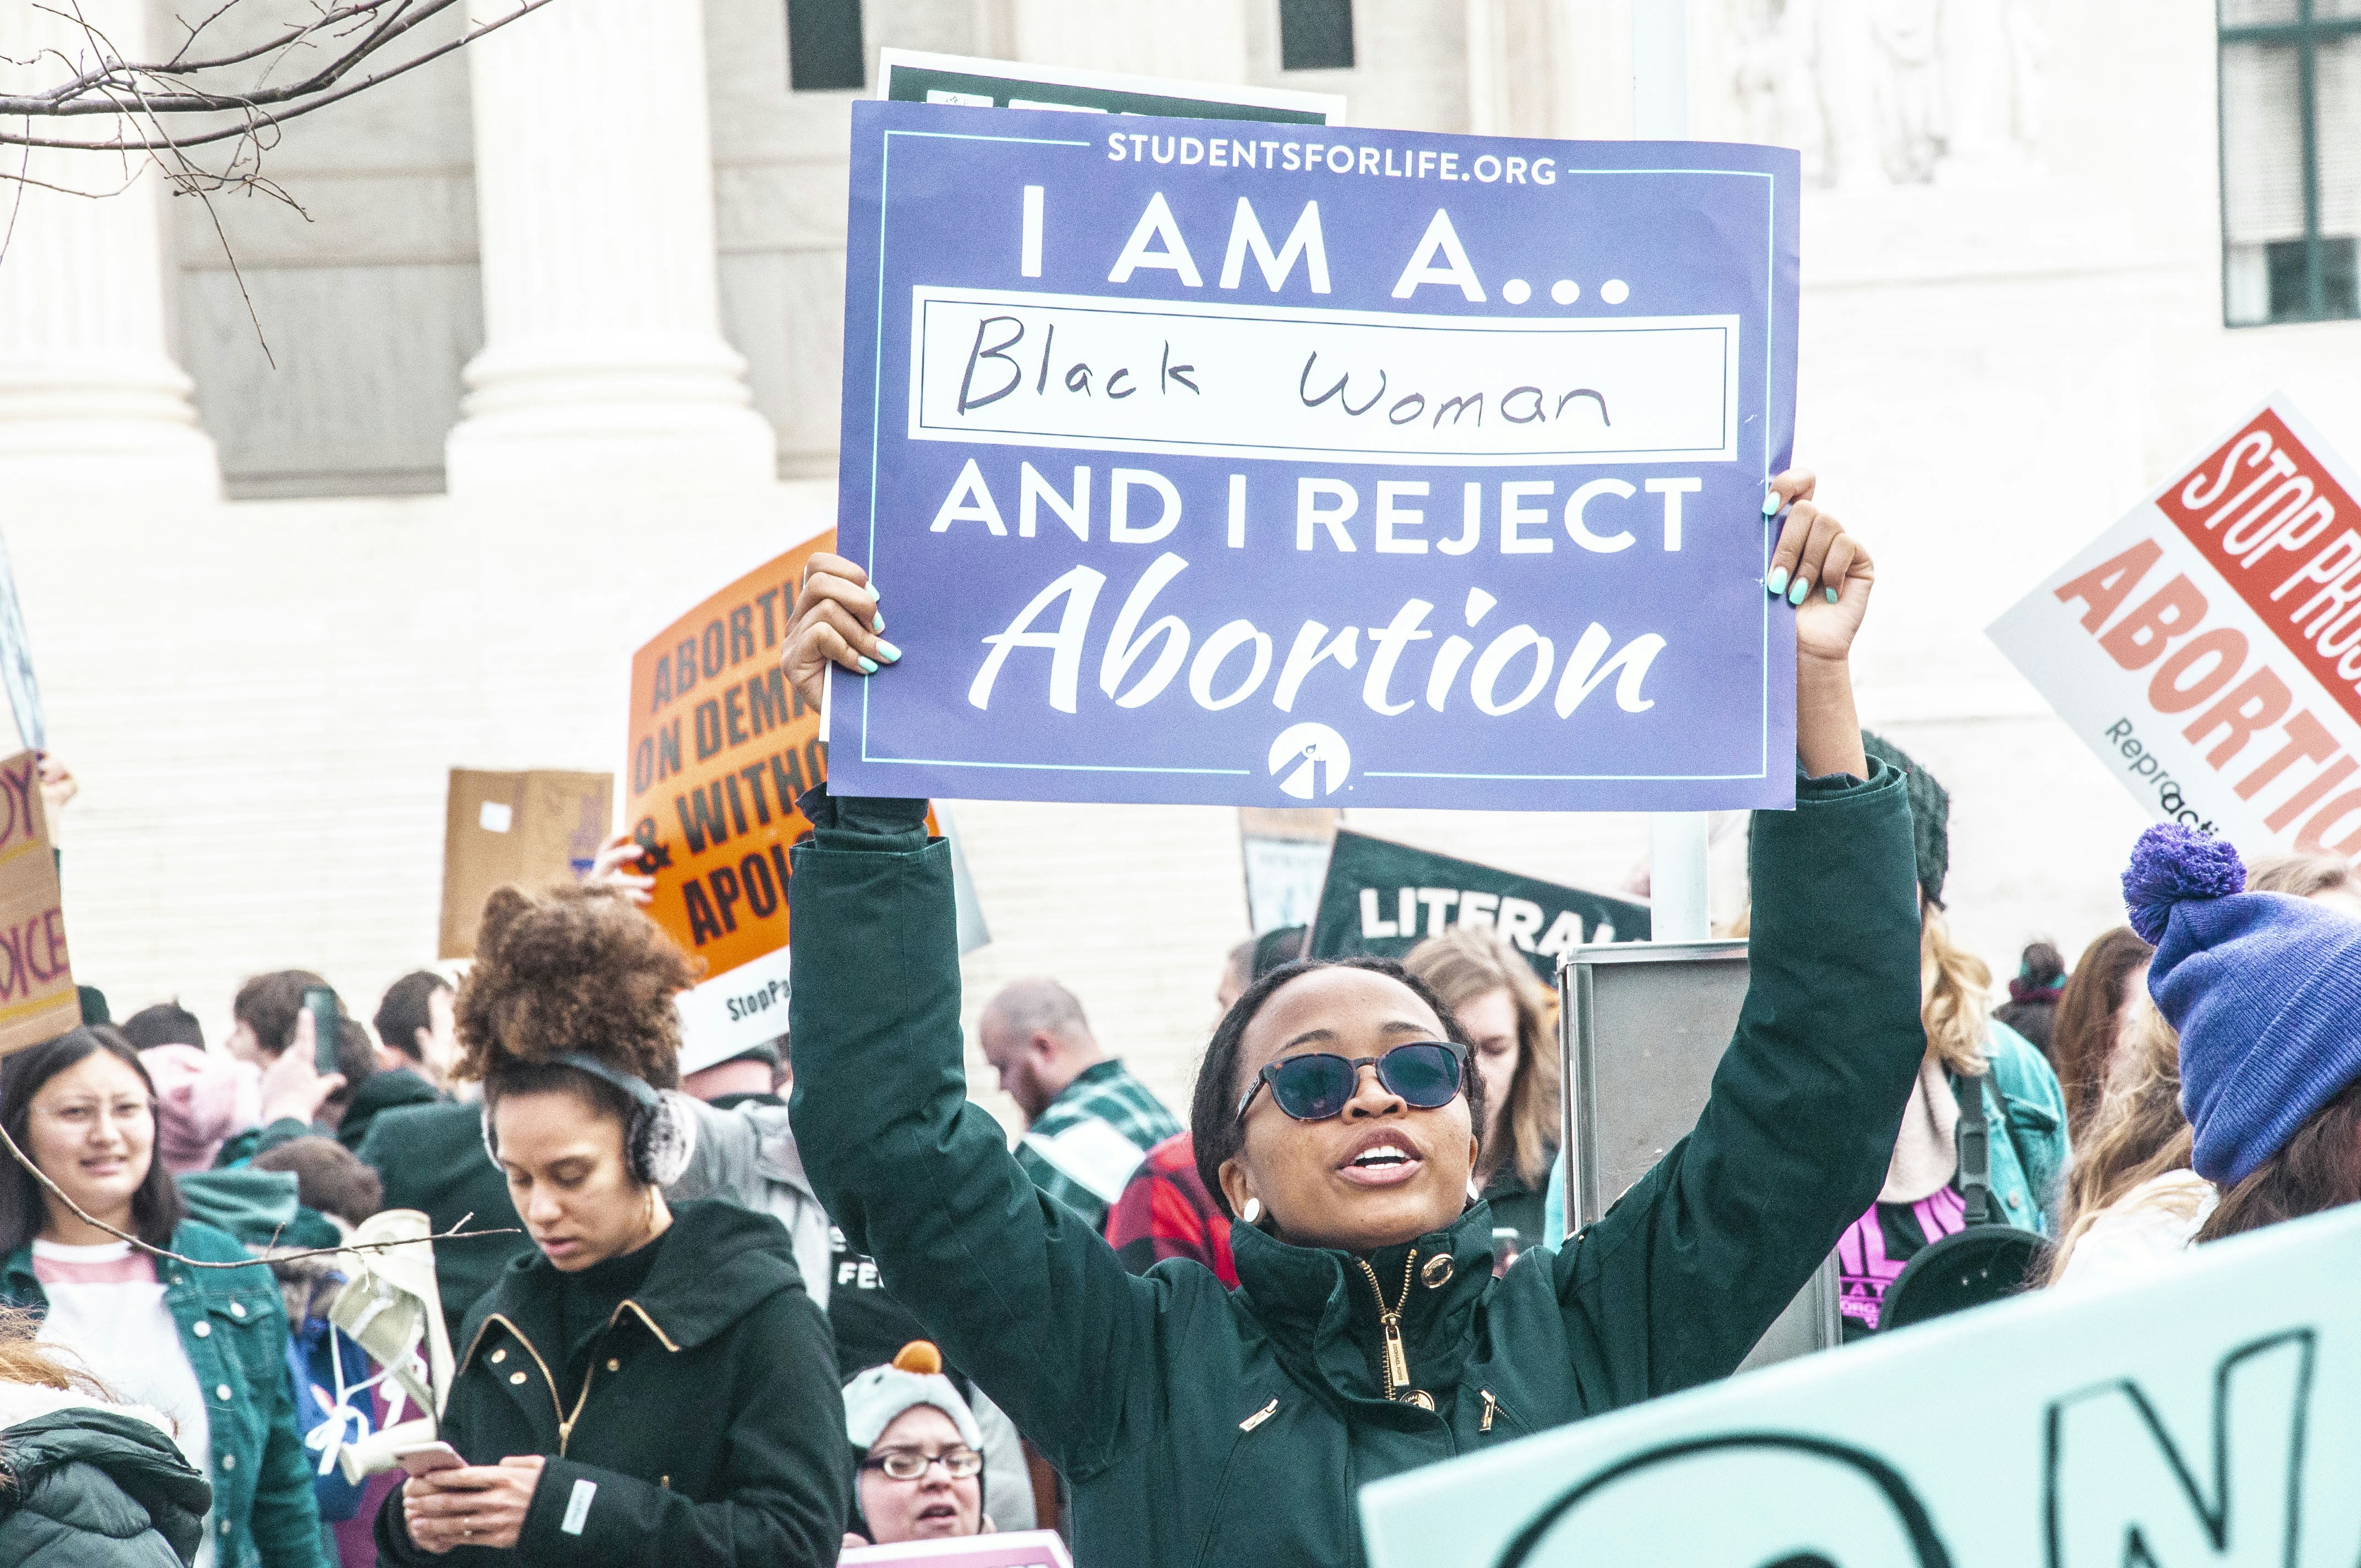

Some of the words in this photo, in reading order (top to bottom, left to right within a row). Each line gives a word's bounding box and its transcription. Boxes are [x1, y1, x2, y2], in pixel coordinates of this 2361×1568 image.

[1108, 133, 1557, 186] STUDENTSFORLIFE.ORG
[1021, 185, 1044, 277] I
[1108, 192, 1331, 294] AM
[958, 317, 1200, 416] Black
[1299, 351, 1611, 427] Woman
[929, 458, 1182, 544] AND
[1227, 474, 1246, 548] I
[1296, 477, 1702, 556] REJECT
[2182, 431, 2335, 569] STOP
[652, 579, 805, 713] ABORTI
[969, 552, 1667, 720] Abortion
[635, 718, 681, 794] ON
[635, 817, 672, 874] &
